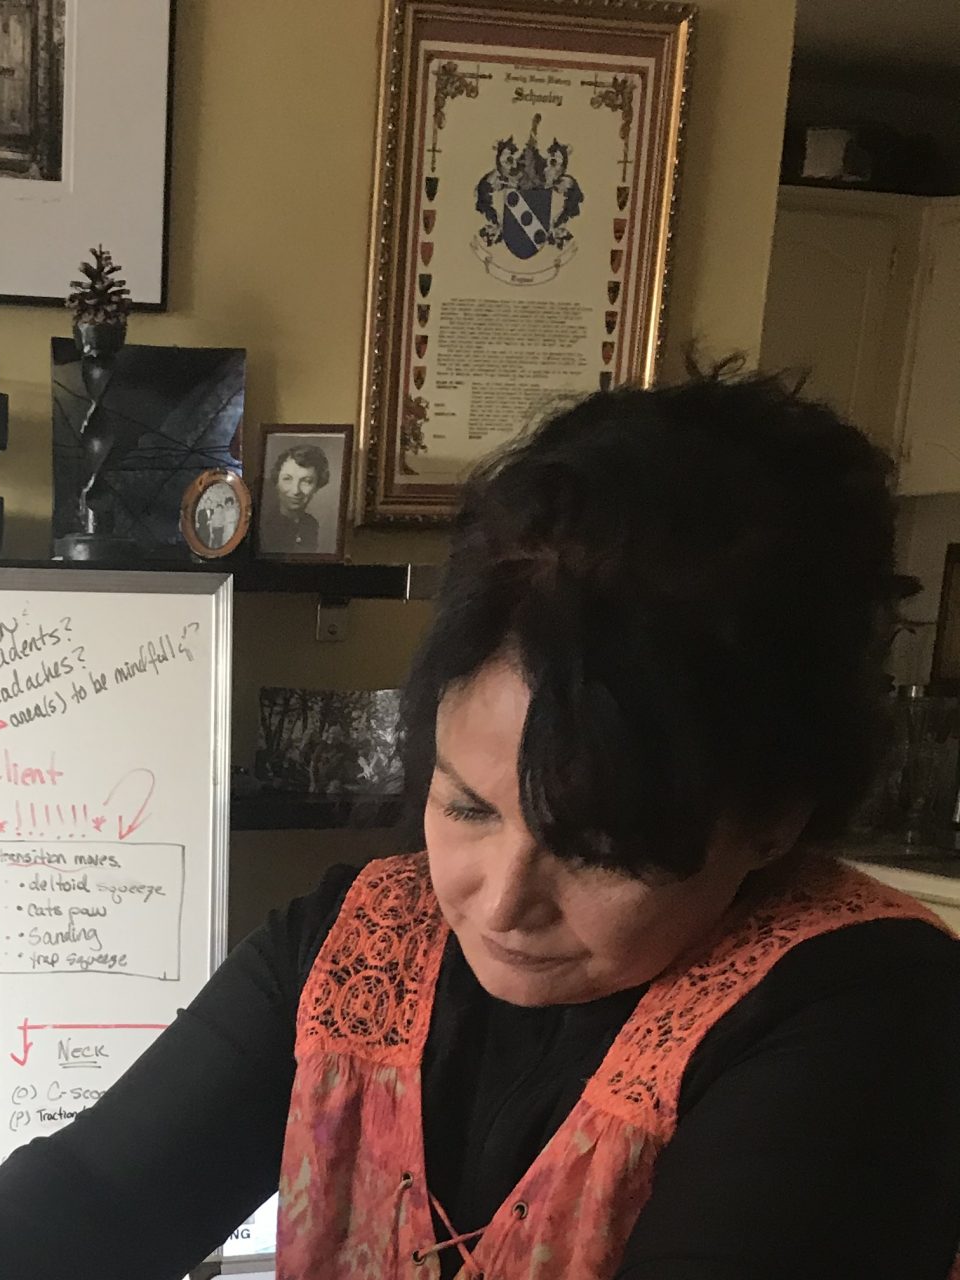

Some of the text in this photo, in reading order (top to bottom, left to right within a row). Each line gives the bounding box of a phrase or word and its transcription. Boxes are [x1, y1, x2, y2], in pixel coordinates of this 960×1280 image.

[10, 691, 67, 728] area(s)
[71, 681, 88, 705] to
[89, 671, 108, 694] be
[29, 873, 90, 893] deltoid
[69, 906, 108, 926] paw
